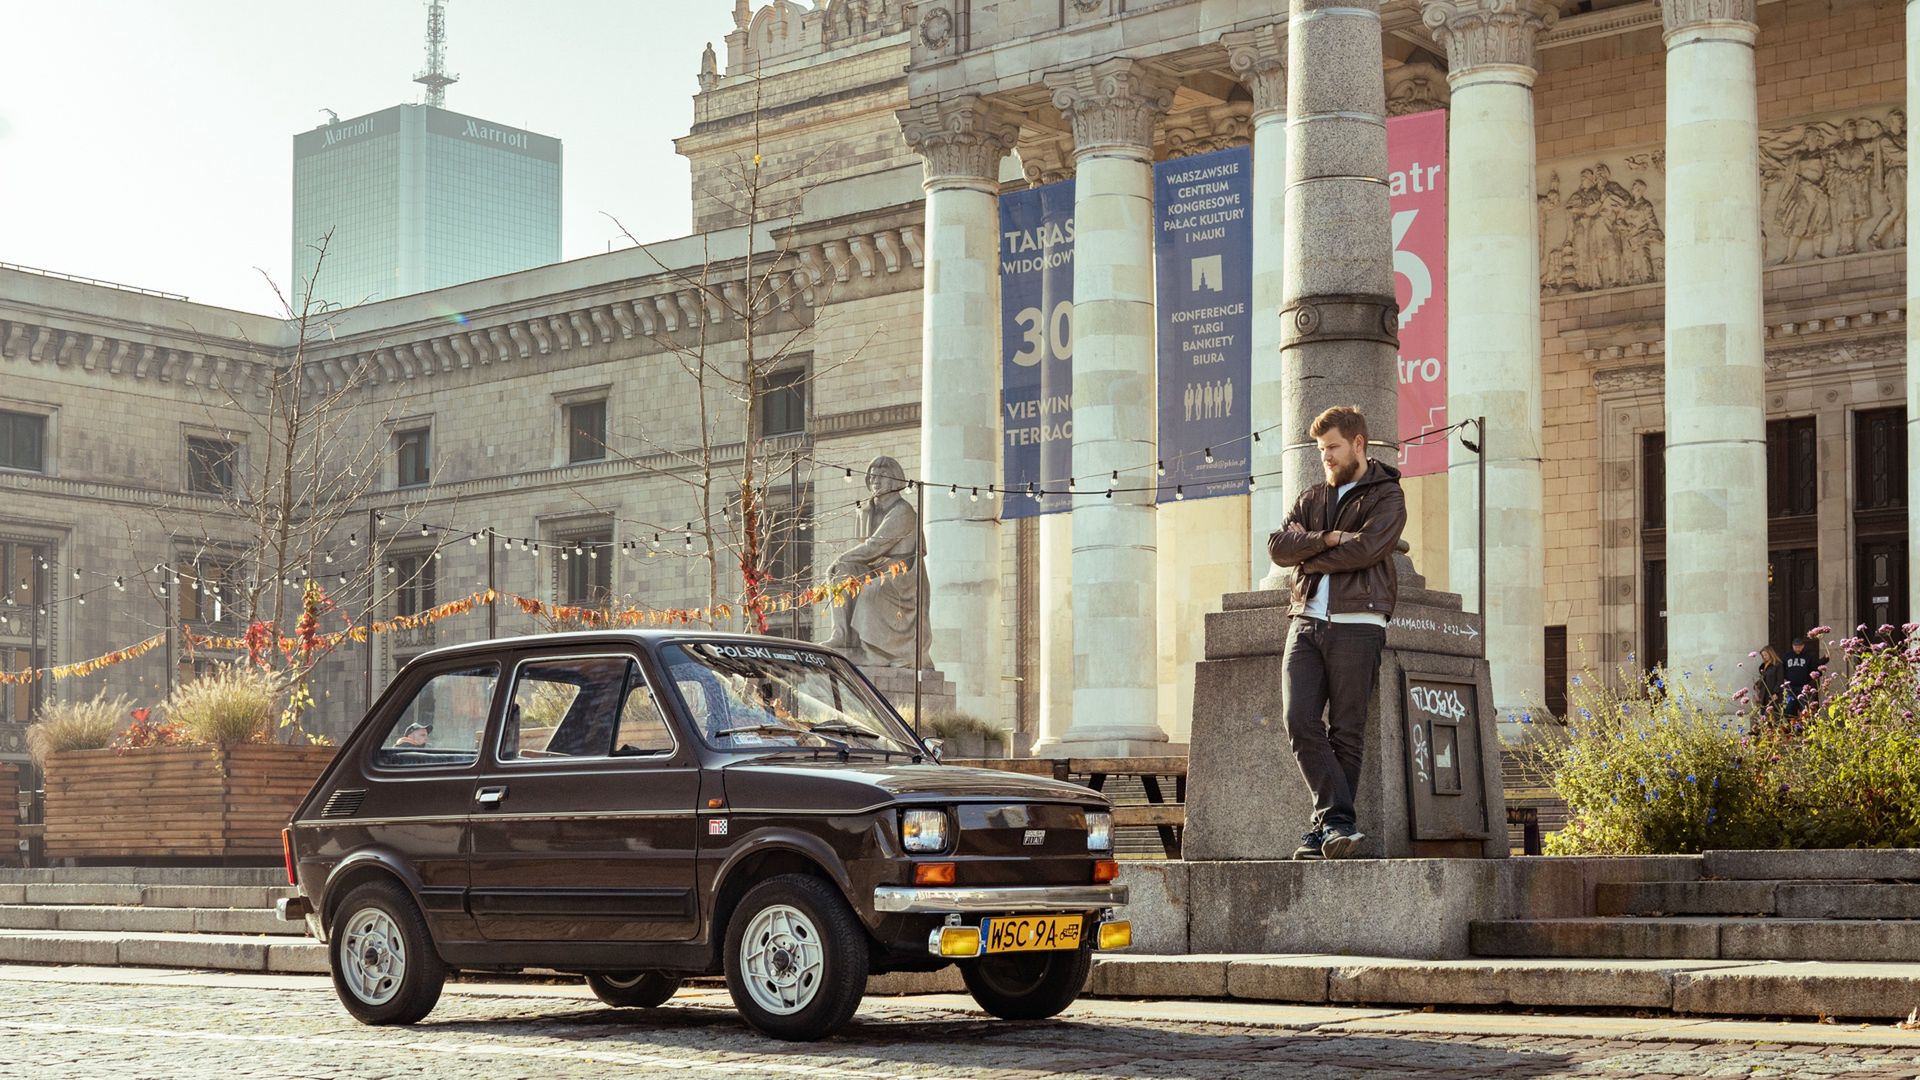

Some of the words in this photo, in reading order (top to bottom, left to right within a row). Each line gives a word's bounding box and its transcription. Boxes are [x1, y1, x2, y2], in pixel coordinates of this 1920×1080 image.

[322, 118, 374, 148] Marriott
[462, 119, 527, 149] Marriott
[1166, 163, 1239, 185] WARSZAWSKIE
[1178, 181, 1229, 199] CENTRUM
[1168, 193, 1240, 215] KONGRESOWE
[1164, 216, 1197, 231] PAŁAC
[1199, 208, 1245, 226] KULTURY
[1185, 233, 1190, 243] I
[1192, 227, 1225, 242] NAUKI
[1171, 303, 1245, 323] KONFERENCJE
[1012, 300, 1073, 367] 30
[1192, 321, 1224, 335] TARGI
[1182, 335, 1234, 352] BANKIETY
[1193, 352, 1225, 365] BIURA
[1006, 393, 1073, 420] VIEWIN
[1206, 480, 1244, 491] www.pkin.pl
[715, 646, 772, 659] POLSKI
[794, 651, 826, 667] 126p
[1787, 658, 1807, 668] GAP
[991, 920, 1030, 949] WSC
[1034, 919, 1057, 948] 9A
